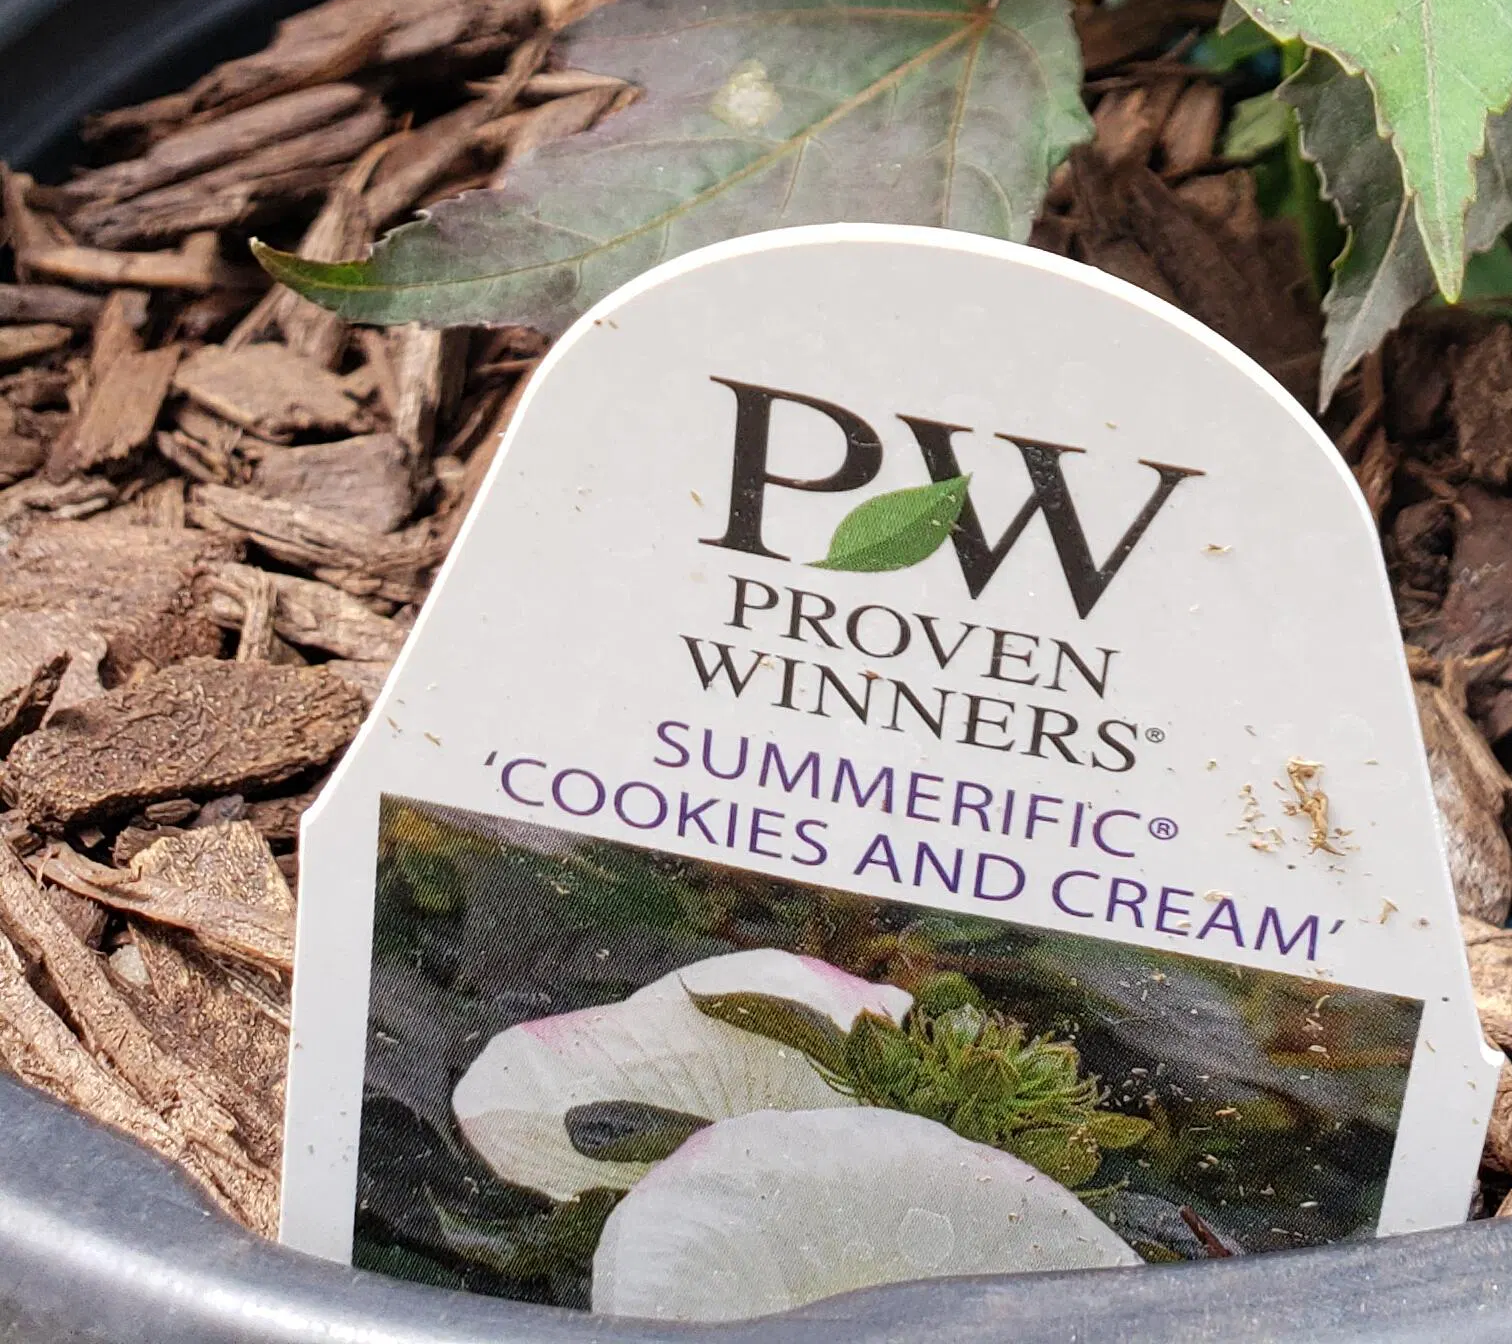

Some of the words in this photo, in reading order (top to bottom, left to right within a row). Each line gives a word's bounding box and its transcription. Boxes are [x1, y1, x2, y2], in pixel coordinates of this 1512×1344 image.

[698, 375, 1206, 620] PW
[679, 634, 1166, 773] WINNERS®
[723, 574, 1121, 700] PROVEN
[653, 719, 1180, 858] SUMMERIFIC®
[853, 833, 1026, 902] AND
